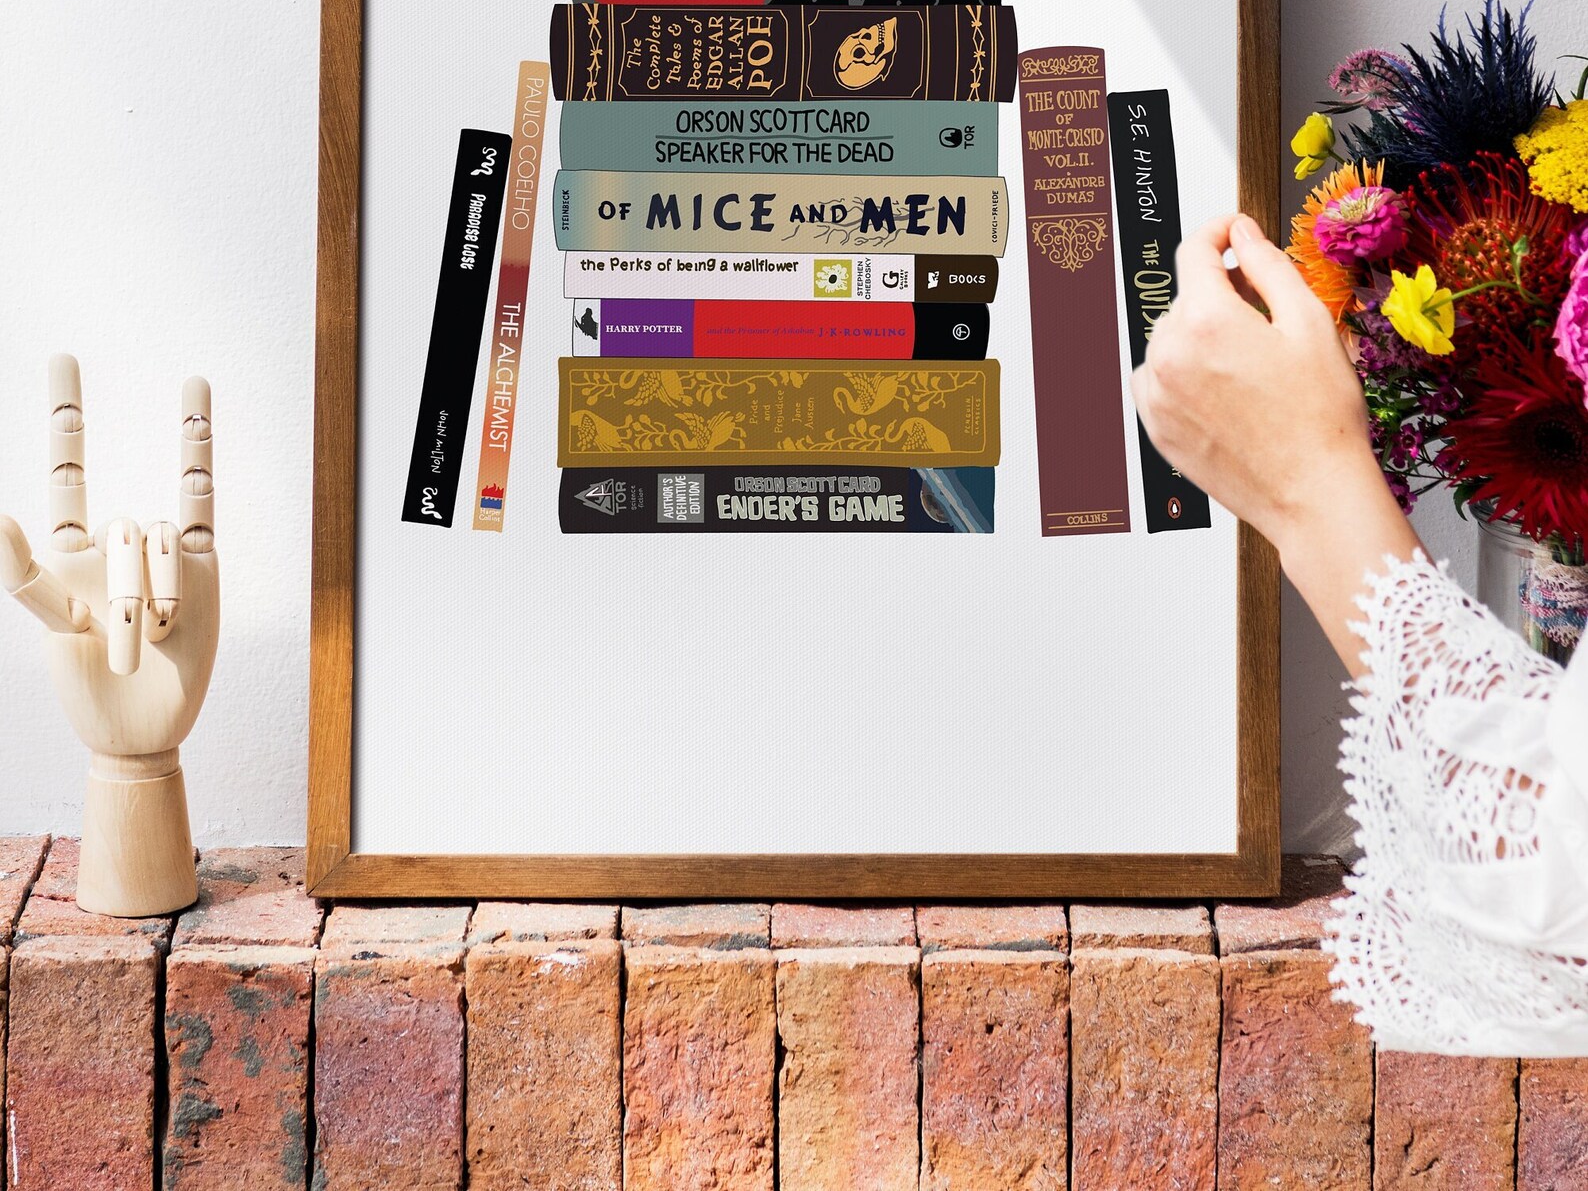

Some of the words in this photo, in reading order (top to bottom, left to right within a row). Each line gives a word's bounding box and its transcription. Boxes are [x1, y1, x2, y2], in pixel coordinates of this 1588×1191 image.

[667, 23, 682, 37] &
[684, 15, 703, 34] of
[626, 37, 642, 69] The
[645, 14, 662, 90] Complete
[666, 42, 682, 84] Tales
[687, 39, 702, 91] Poems
[705, 15, 724, 90] EDGAR
[727, 16, 744, 90] ALLAN
[746, 15, 774, 91] POE
[521, 77, 545, 139] PAULO
[1025, 91, 1054, 113] THE
[1056, 89, 1100, 110] COUNT
[676, 109, 744, 133] ORSON
[1056, 113, 1074, 125] OF
[1128, 103, 1150, 142] S.E.
[964, 125, 976, 150] TOR
[1027, 127, 1105, 151] MONTE-CRISTO
[655, 140, 744, 164] SPEAKER
[749, 142, 788, 164] FOR
[792, 142, 832, 164] THE
[837, 142, 894, 163] DEAD
[512, 144, 537, 230] COELHO
[1034, 176, 1106, 191] ALEXANDRE
[1133, 148, 1163, 223] HINTON
[562, 189, 570, 231] STEINBECK
[1046, 191, 1095, 205] DUMAS
[598, 200, 632, 221] OF
[646, 192, 777, 232] MICE
[789, 203, 848, 224] AND
[859, 194, 966, 236] MEN
[580, 258, 606, 272] the
[610, 257, 652, 272] Perks
[657, 258, 672, 272] of
[676, 258, 716, 272] being
[719, 261, 728, 272] a
[732, 258, 800, 272] wallflower
[1142, 239, 1160, 266] THE
[882, 270, 900, 288] G
[948, 274, 986, 284] BOOKS
[500, 302, 521, 338] THE
[606, 325, 640, 334] HARRY
[642, 325, 683, 334] POTTER
[488, 342, 516, 452] ALCHEMIST
[437, 410, 449, 437] JOHN
[749, 399, 758, 425] Pride
[763, 404, 771, 422] and
[792, 402, 802, 422] Jane
[804, 397, 815, 430] Austen
[615, 481, 627, 514] TOR
[662, 477, 674, 519] AUTHOR'S
[674, 475, 688, 521] DEFINITIVE
[688, 481, 700, 515] EDITION
[734, 476, 786, 494] ORSON
[786, 476, 838, 494] SCOTT
[838, 475, 882, 494] CARD
[716, 494, 820, 522] ENDER'S
[828, 494, 906, 522] GAME
[1067, 512, 1109, 526] COLLINS
